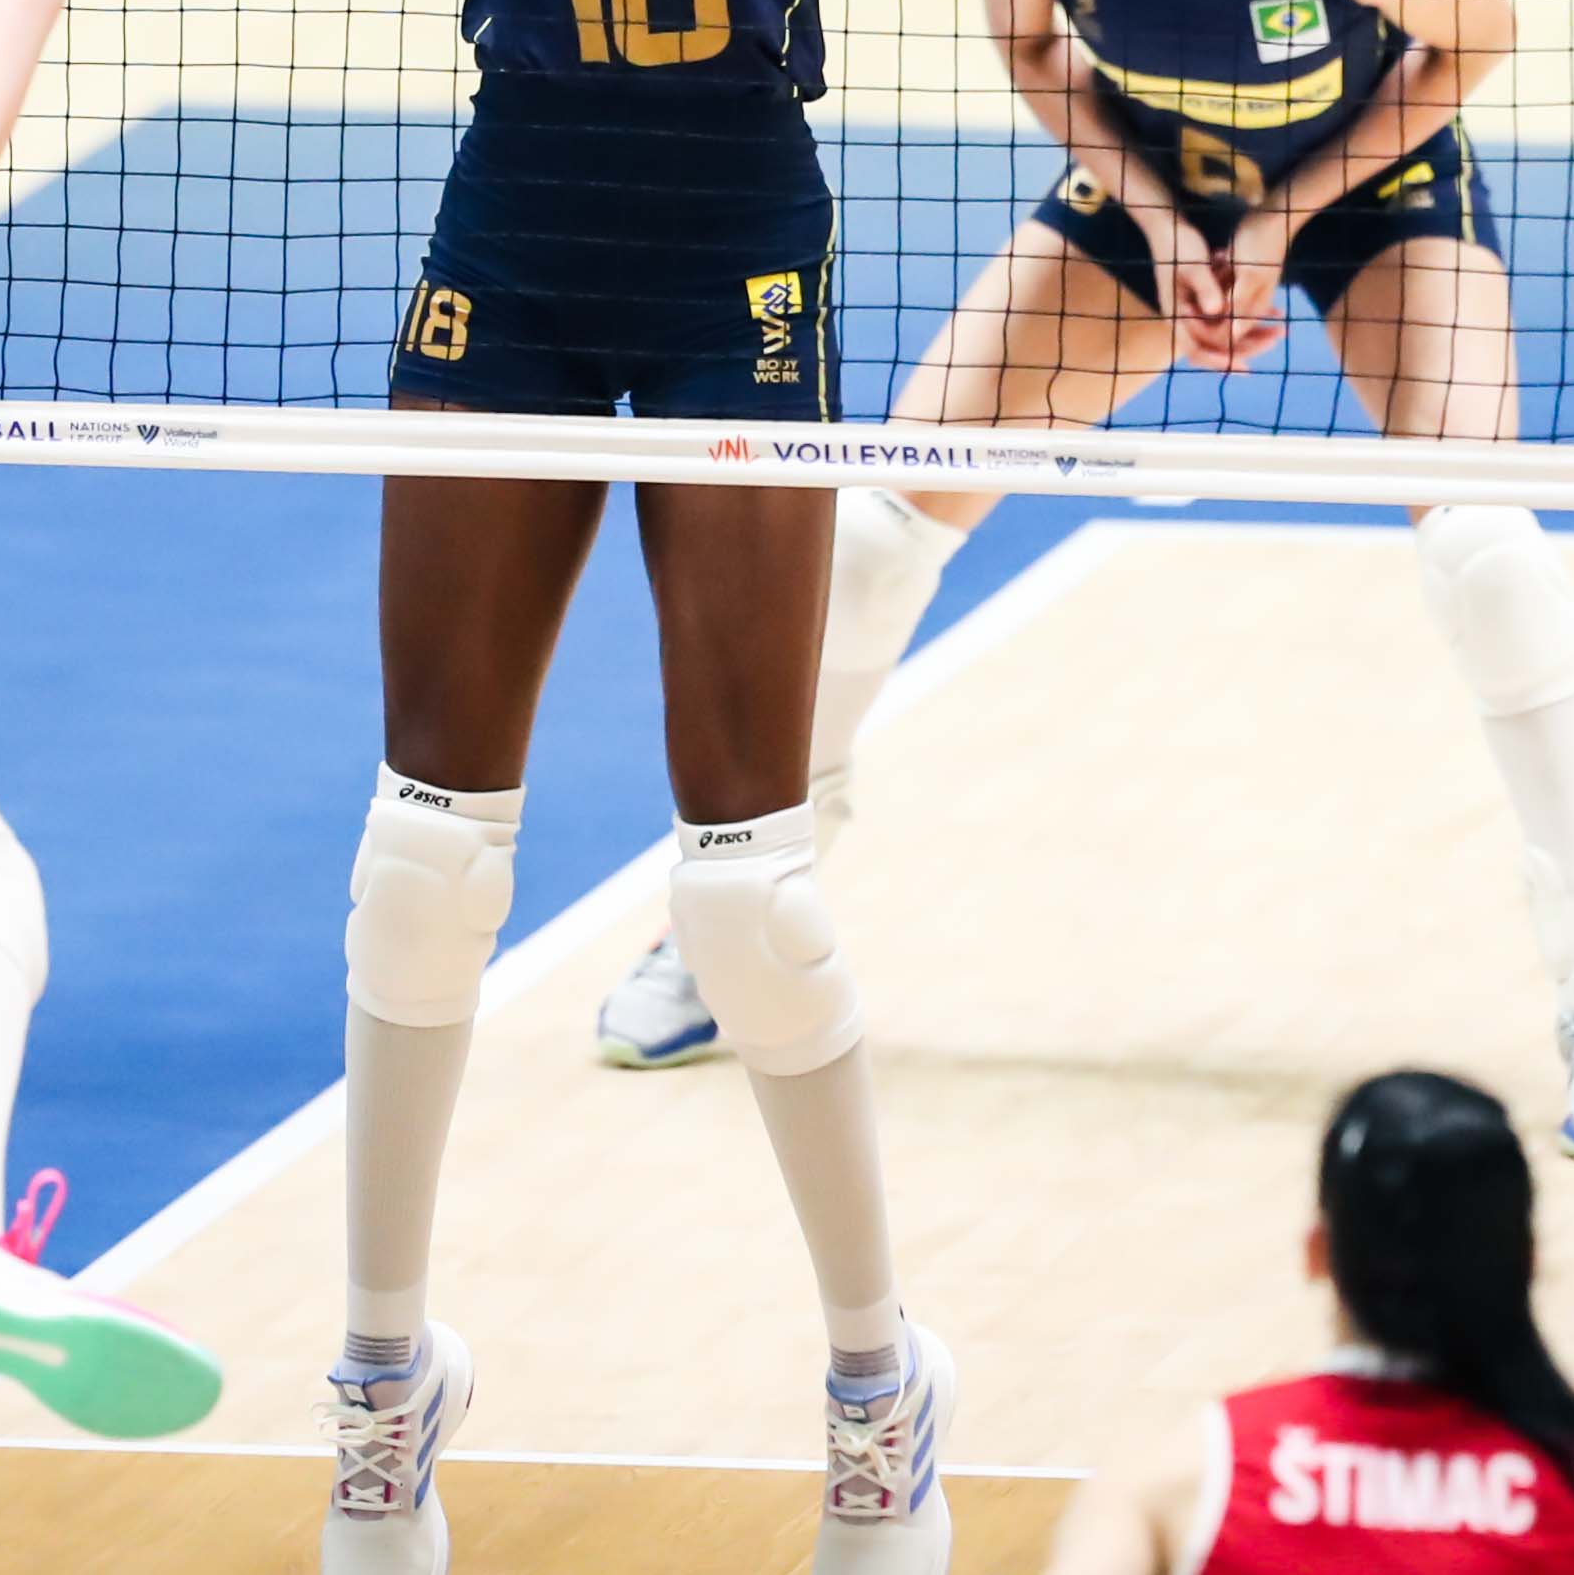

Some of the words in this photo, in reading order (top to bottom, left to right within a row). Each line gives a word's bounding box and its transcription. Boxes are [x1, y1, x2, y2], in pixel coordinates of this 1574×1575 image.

[405, 279, 473, 363] 18
[773, 441, 980, 469] VOLLEYBALL
[1268, 1423, 1539, 1537] ŠTIMAC
